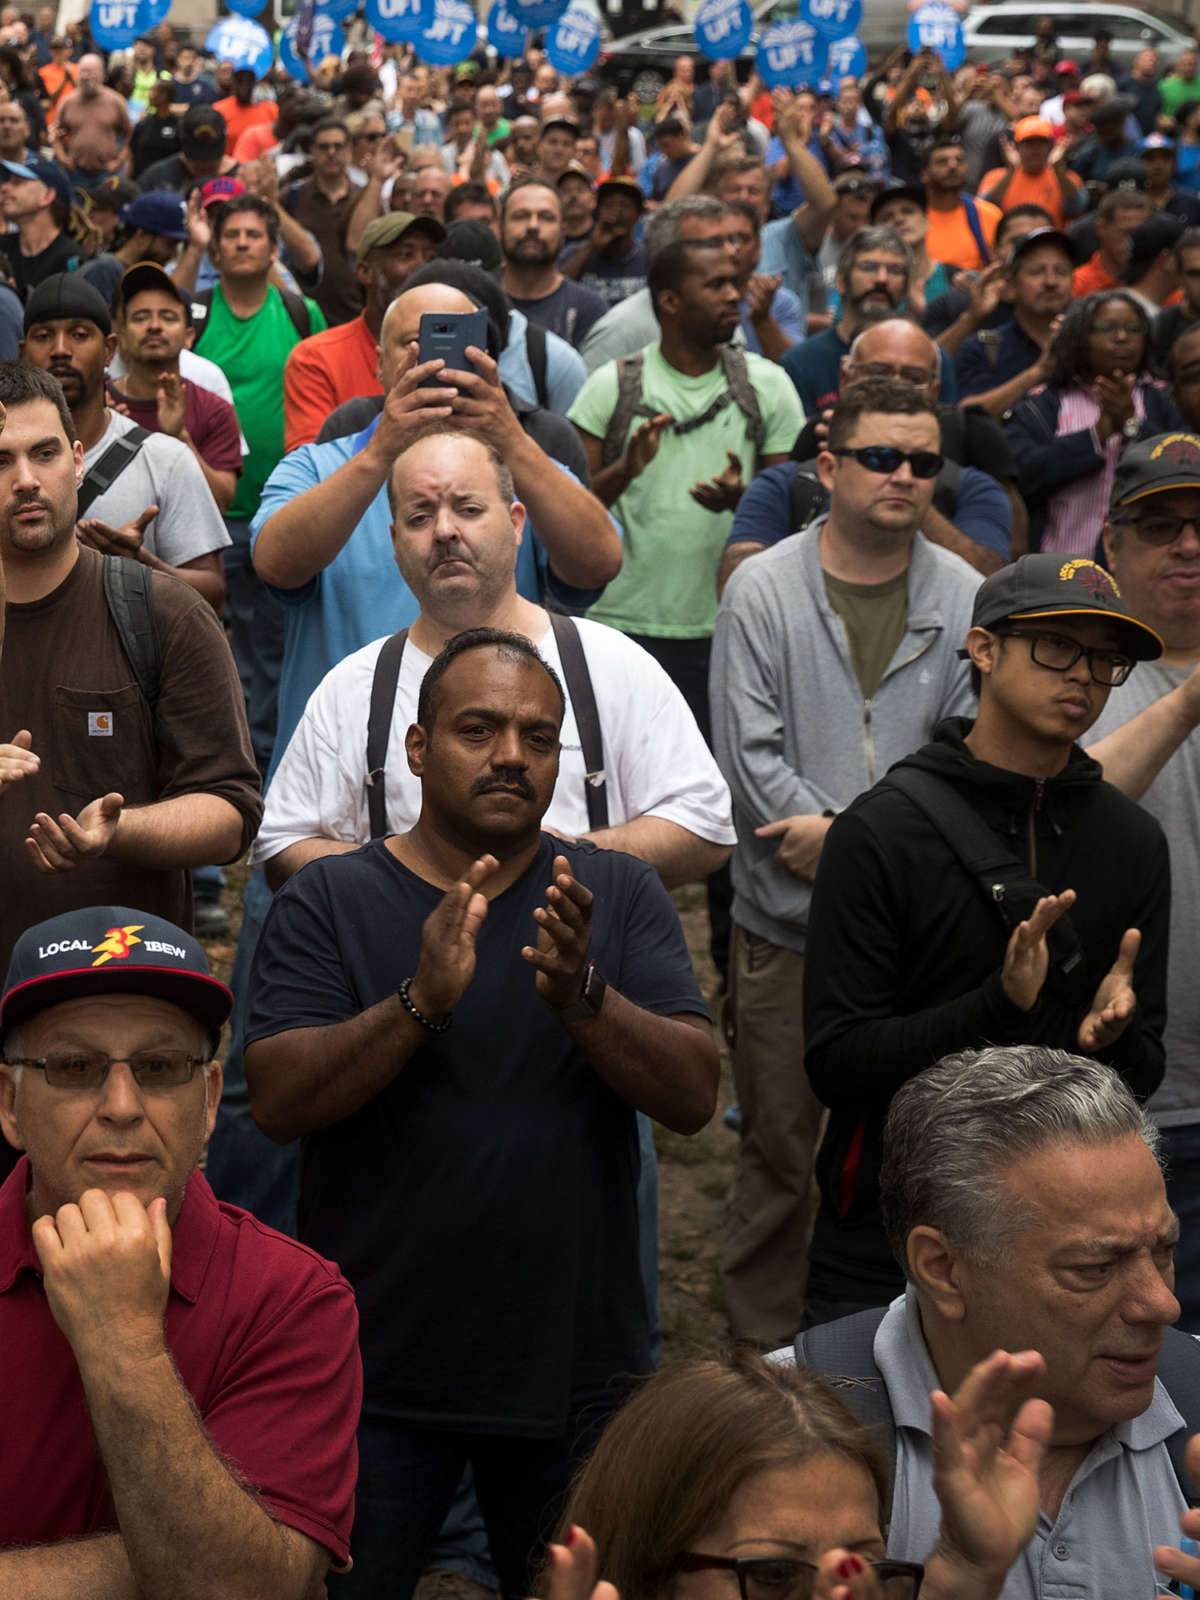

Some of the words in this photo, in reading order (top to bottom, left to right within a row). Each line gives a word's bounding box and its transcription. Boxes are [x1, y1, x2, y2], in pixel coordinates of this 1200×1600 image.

[99, 5, 138, 28] UFT
[703, 8, 742, 43] UFT
[555, 27, 591, 56] UFT
[767, 39, 815, 72] UFT
[39, 939, 93, 959] LOCAL
[104, 927, 131, 959] 3
[143, 940, 187, 959] IBEW
